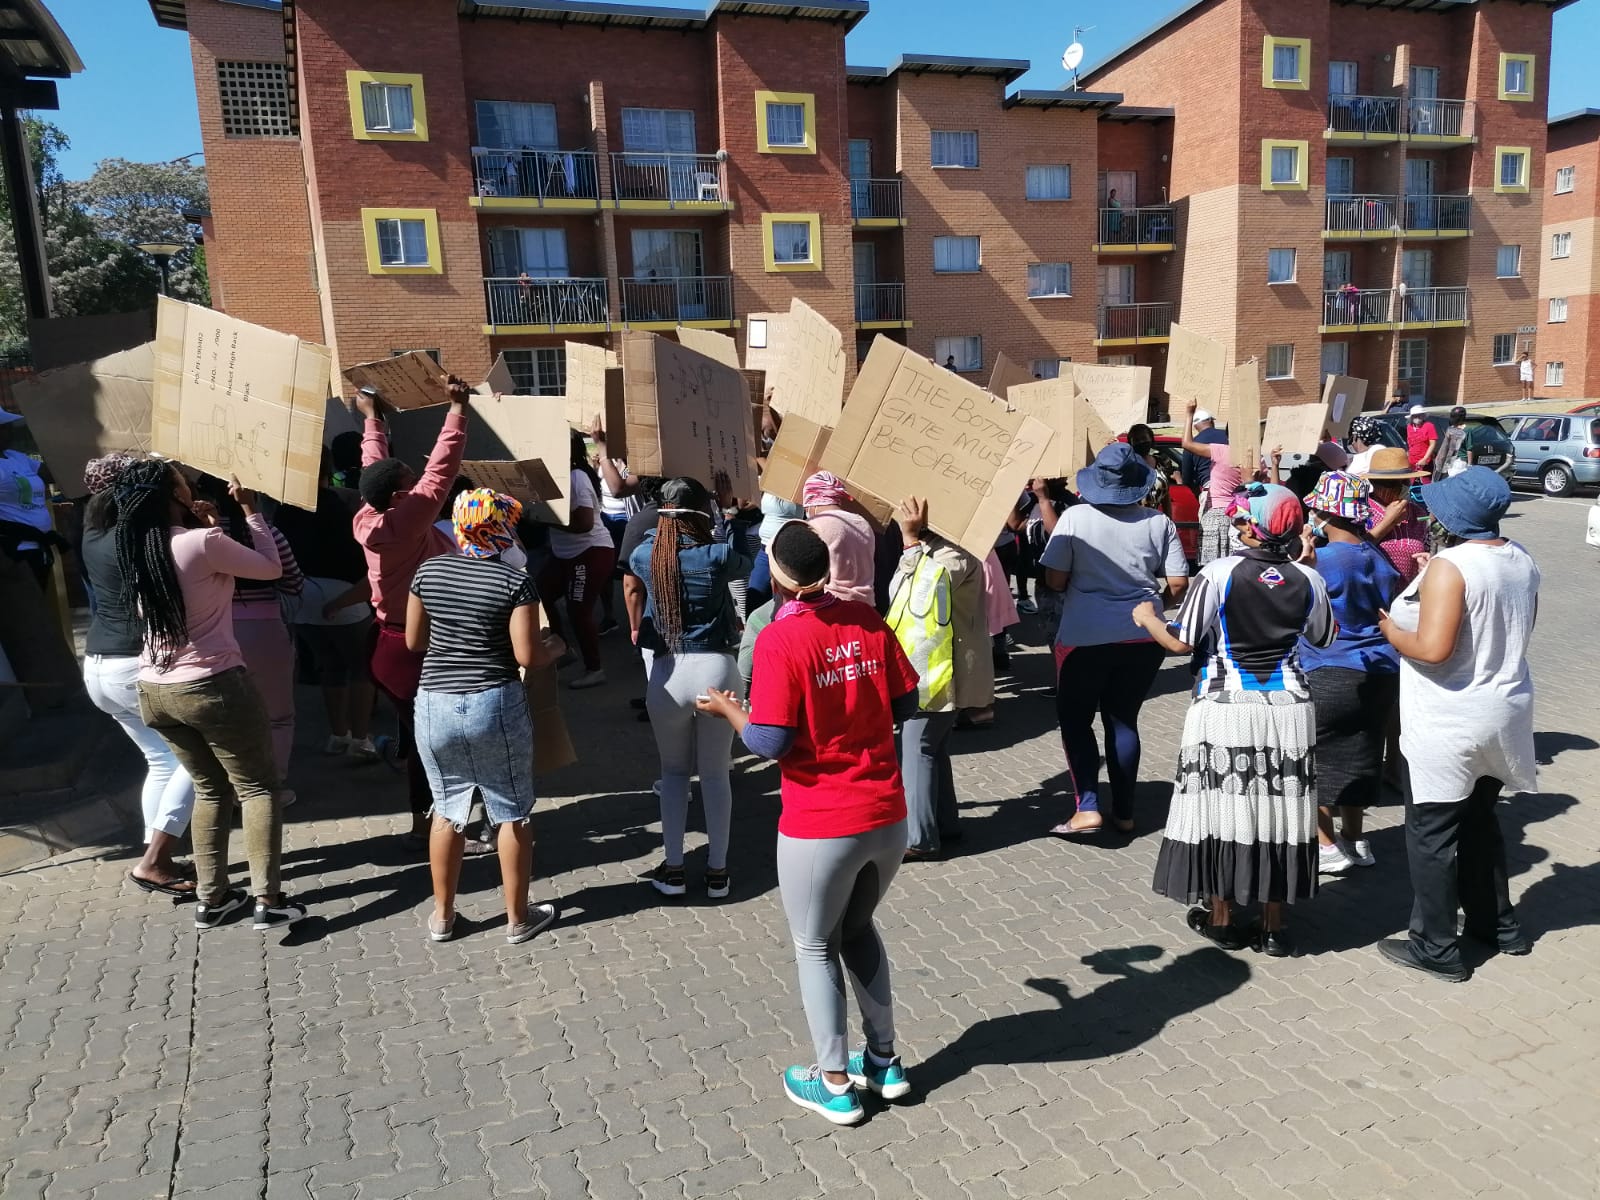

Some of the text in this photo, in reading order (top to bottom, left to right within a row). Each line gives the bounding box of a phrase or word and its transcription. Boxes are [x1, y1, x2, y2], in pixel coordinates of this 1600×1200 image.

[904, 366, 950, 410] THE
[880, 397, 945, 441] GATE
[870, 424, 993, 499] BE OPENED
[824, 640, 862, 663] SAVE
[815, 659, 878, 689] WATER!!!
